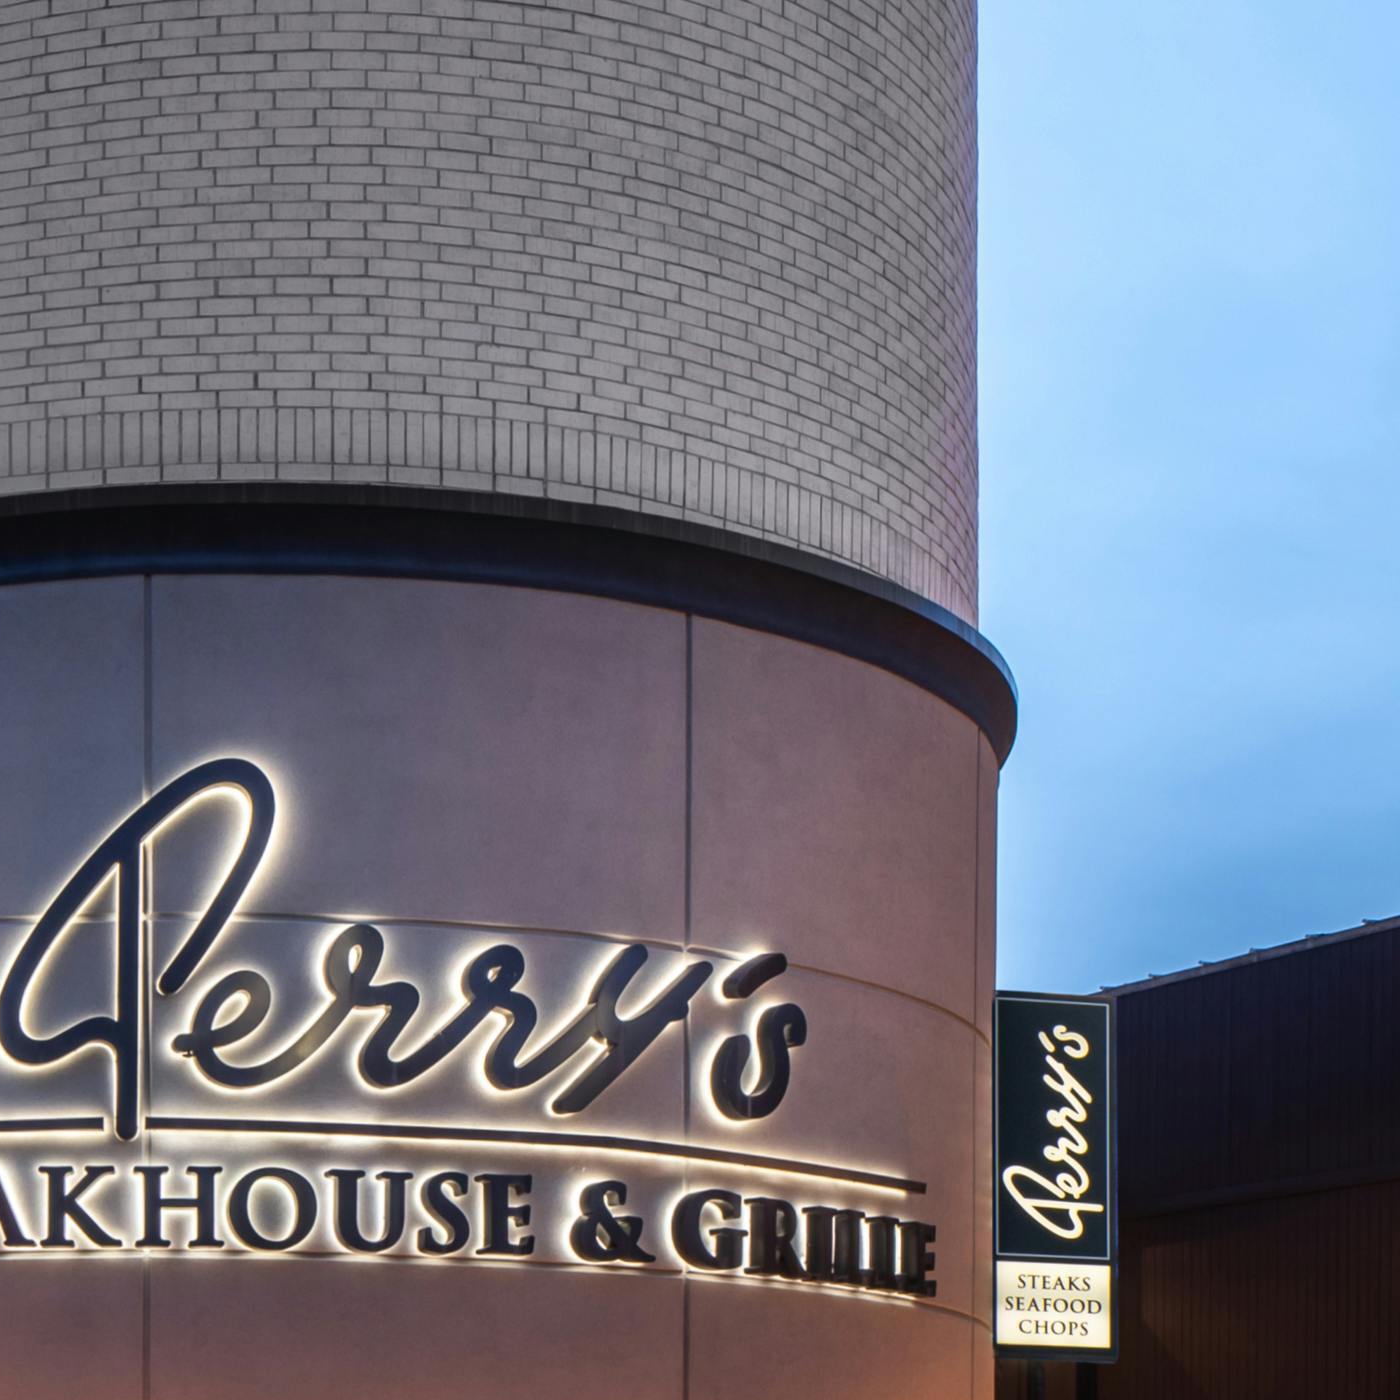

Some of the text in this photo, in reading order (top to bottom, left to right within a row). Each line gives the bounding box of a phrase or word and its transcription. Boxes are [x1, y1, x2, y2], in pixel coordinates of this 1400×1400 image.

[1002, 1024, 1104, 1239] Perry's
[570, 1179, 656, 1264] &
[670, 1189, 937, 1298] GRILLE
[1017, 1274, 1092, 1292] STEAKS
[1004, 1296, 1103, 1315] SEAFOOD
[1018, 1319, 1090, 1337] CHOPS
